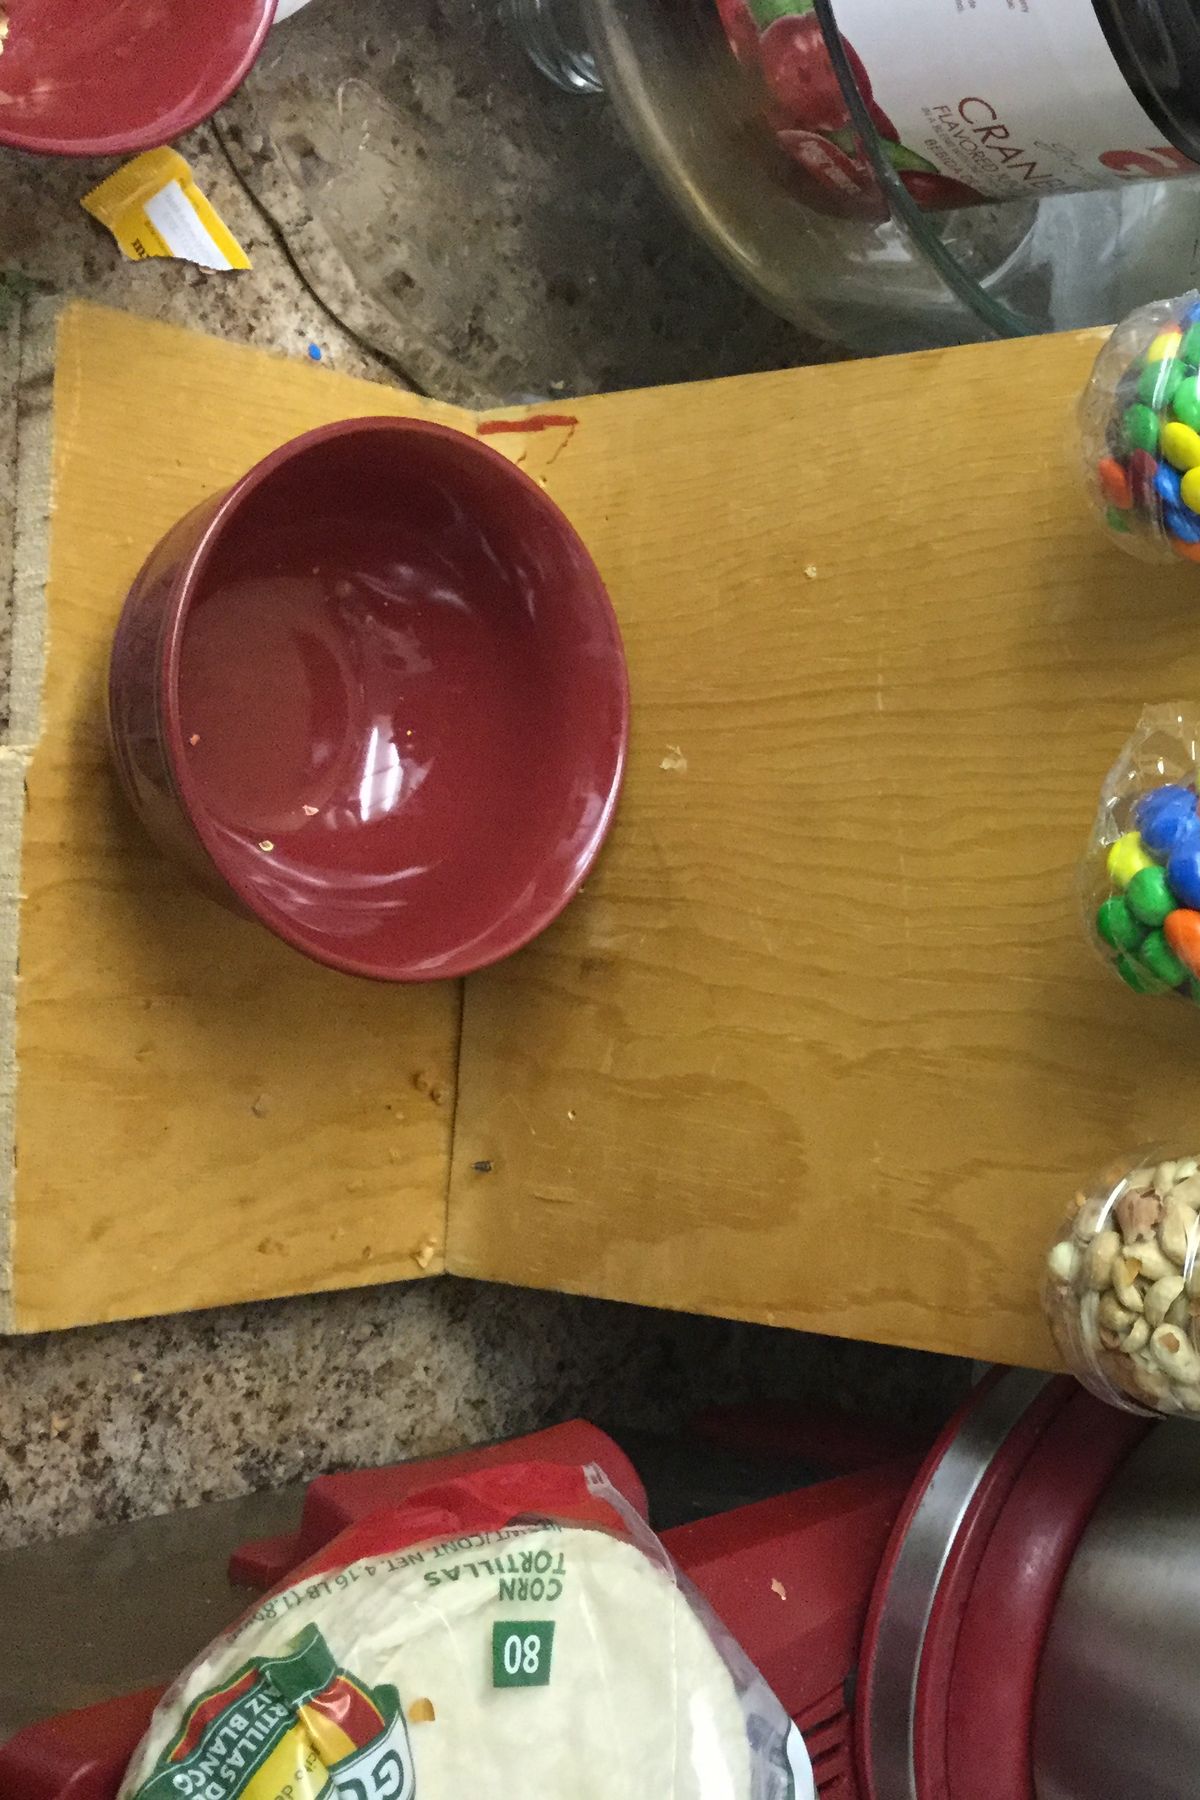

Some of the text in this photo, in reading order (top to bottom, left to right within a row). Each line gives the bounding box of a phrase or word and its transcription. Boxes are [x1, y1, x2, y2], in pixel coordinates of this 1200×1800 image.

[933, 105, 999, 172] FLAVORED
[335, 1565, 378, 1589] 4.16
[423, 1550, 566, 1587] TORTILLAS
[306, 1581, 332, 1599] LB
[498, 1577, 563, 1601] CORN
[504, 1634, 541, 1675] 80
[172, 1712, 250, 1796] BLANCO
[220, 1702, 292, 1784] RTILLAS
